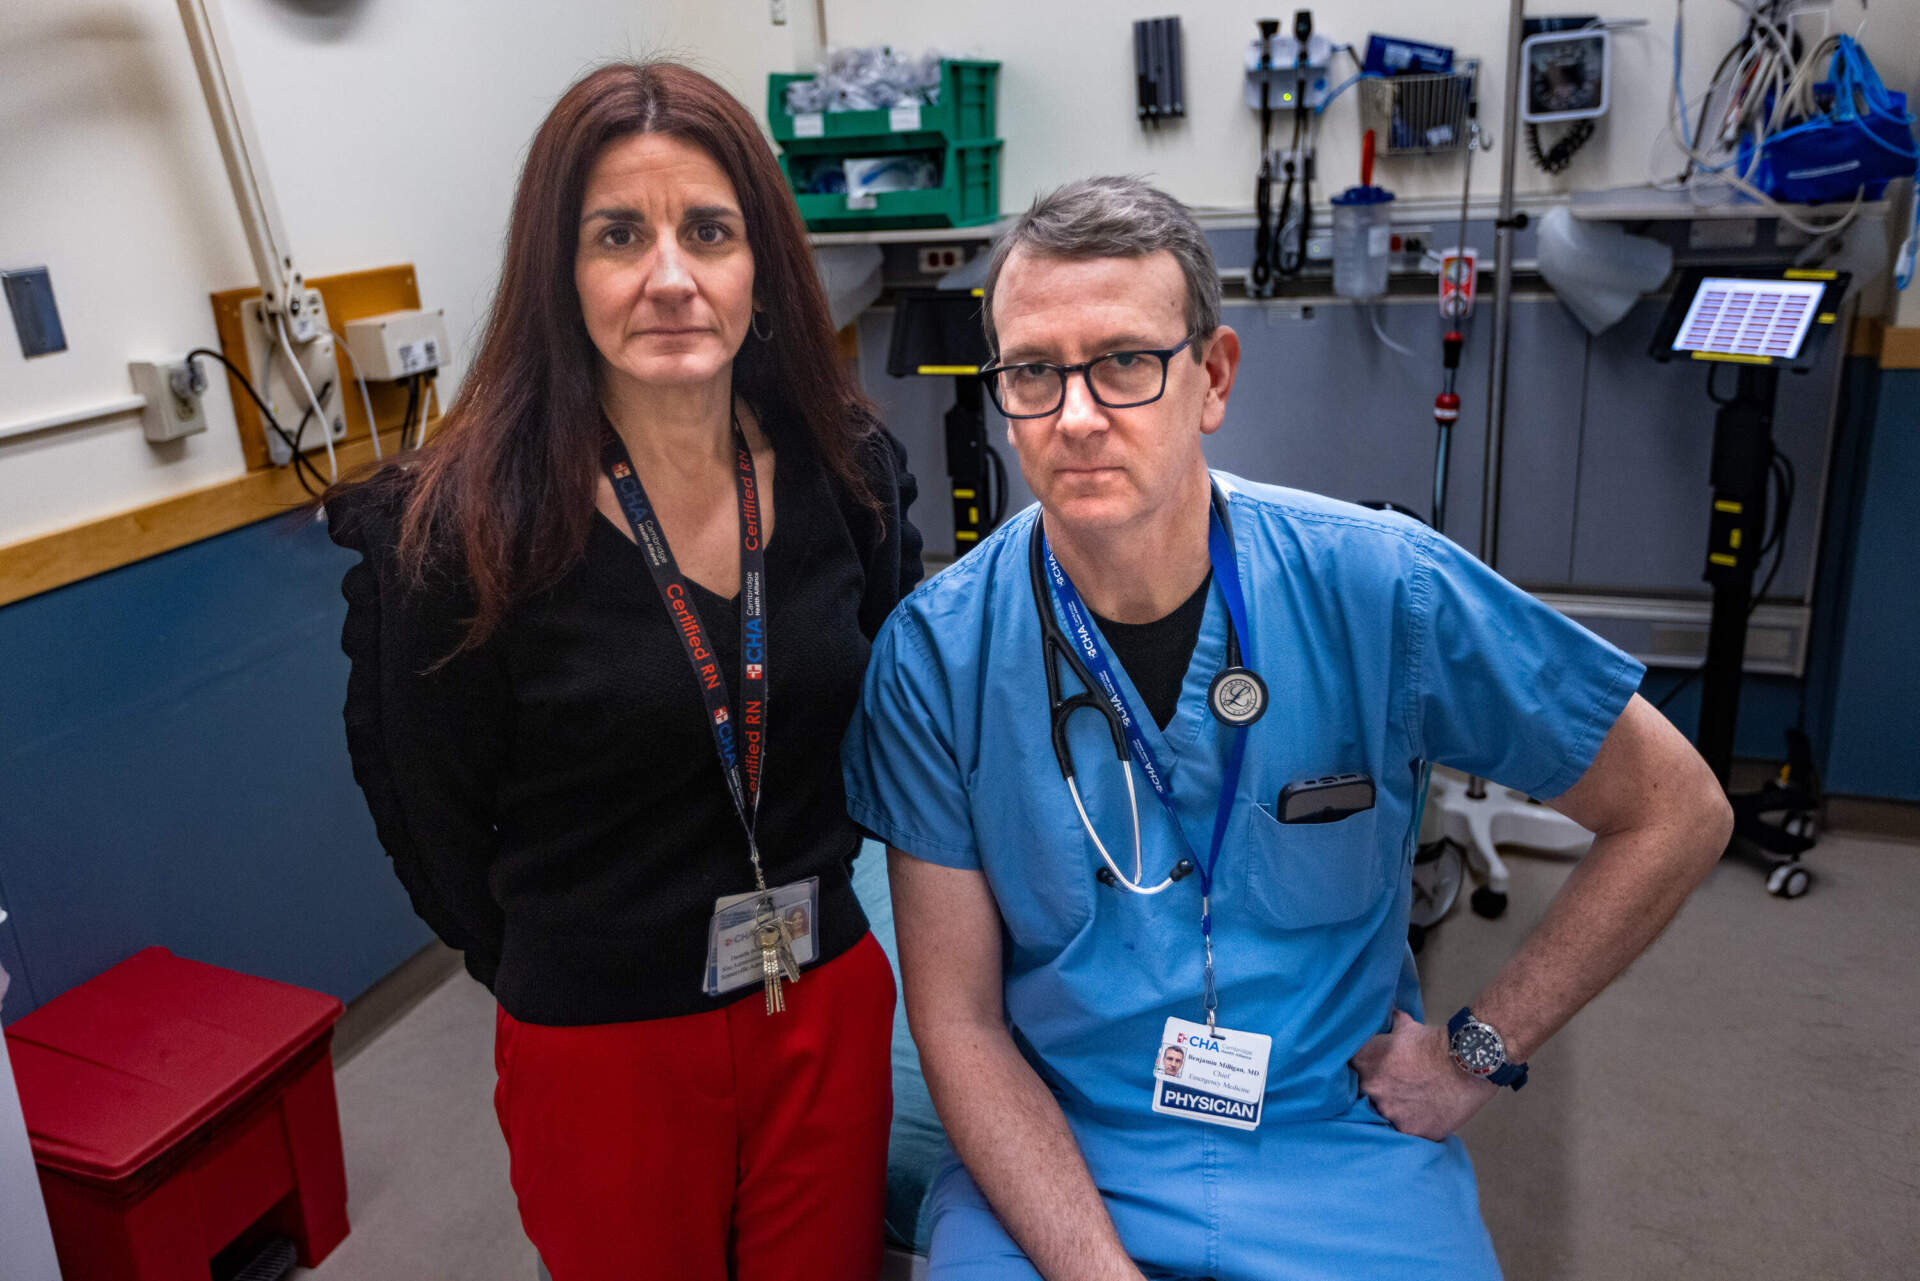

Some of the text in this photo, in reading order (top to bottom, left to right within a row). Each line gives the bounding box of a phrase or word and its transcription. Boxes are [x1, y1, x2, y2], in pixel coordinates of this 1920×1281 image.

[620, 479, 649, 522] CHA
[738, 449, 759, 552] Certified RN
[1048, 552, 1062, 578] CHA
[744, 571, 754, 616] Cambridge
[666, 584, 721, 690] Certified RN
[745, 618, 763, 663] CHA
[1077, 624, 1094, 651] CHA
[745, 701, 761, 725] RN
[1144, 761, 1161, 787] CHA
[1189, 1036, 1220, 1053] CHA
[1188, 1054, 1217, 1066] Benjamin
[1247, 1068, 1260, 1076] MD
[1213, 1070, 1231, 1079] Chief
[1188, 1073, 1250, 1094] Emergency Medicine
[1165, 1090, 1255, 1119] PHYSICIAN
